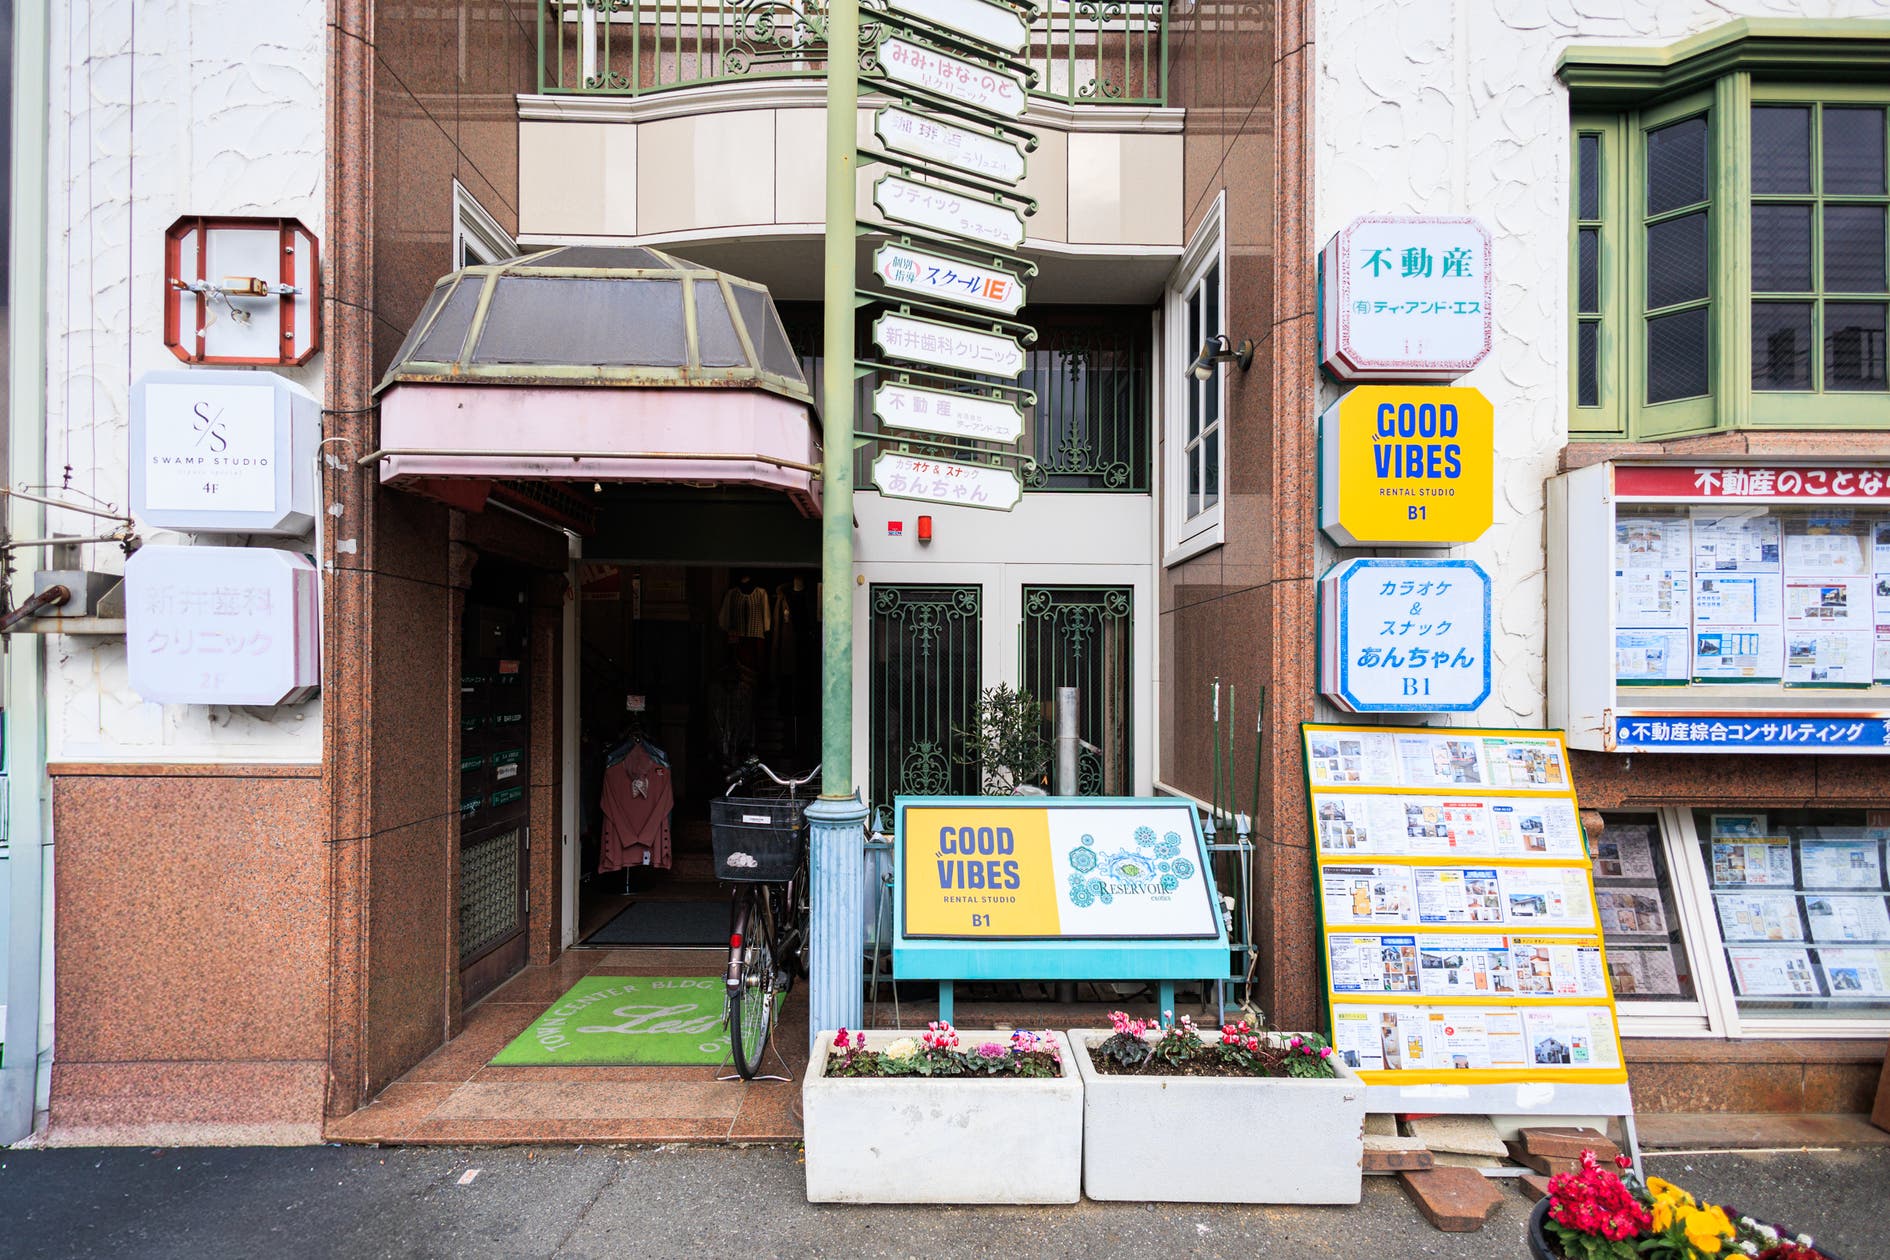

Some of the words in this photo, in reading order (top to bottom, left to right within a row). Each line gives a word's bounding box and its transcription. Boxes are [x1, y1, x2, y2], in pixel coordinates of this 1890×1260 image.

[1360, 246, 1473, 279] 不動産
[885, 326, 1018, 366] 新井歯科クリニック
[889, 391, 952, 417] 不動産
[1377, 403, 1459, 438] GOOD
[152, 456, 205, 465] SWAMP
[213, 457, 269, 466] STUDIO
[895, 458, 930, 473] カラオケ
[933, 466, 940, 475] &
[946, 466, 979, 480] スナック
[1373, 443, 1462, 479] VIBES
[202, 482, 220, 494] 4F
[888, 472, 989, 502] あんちゃん
[1379, 488, 1416, 496] RENTAL
[1419, 488, 1455, 497] STUDIO
[1694, 468, 1890, 495] 不動産のことな
[1407, 505, 1426, 520] B1
[1379, 580, 1453, 596] カラオケ
[1409, 601, 1422, 616] &
[1379, 620, 1453, 636] スナック
[147, 627, 273, 656] クリニック
[1356, 646, 1475, 669] あんちゃん
[1402, 677, 1431, 696] B1
[1632, 722, 1865, 742] 不動産綜合コンサルティング
[939, 826, 1014, 856] GOOD
[936, 860, 1021, 889] VIBES
[943, 895, 979, 903] RENTAL
[981, 895, 1016, 904] STUDIO
[972, 914, 990, 927] B1
